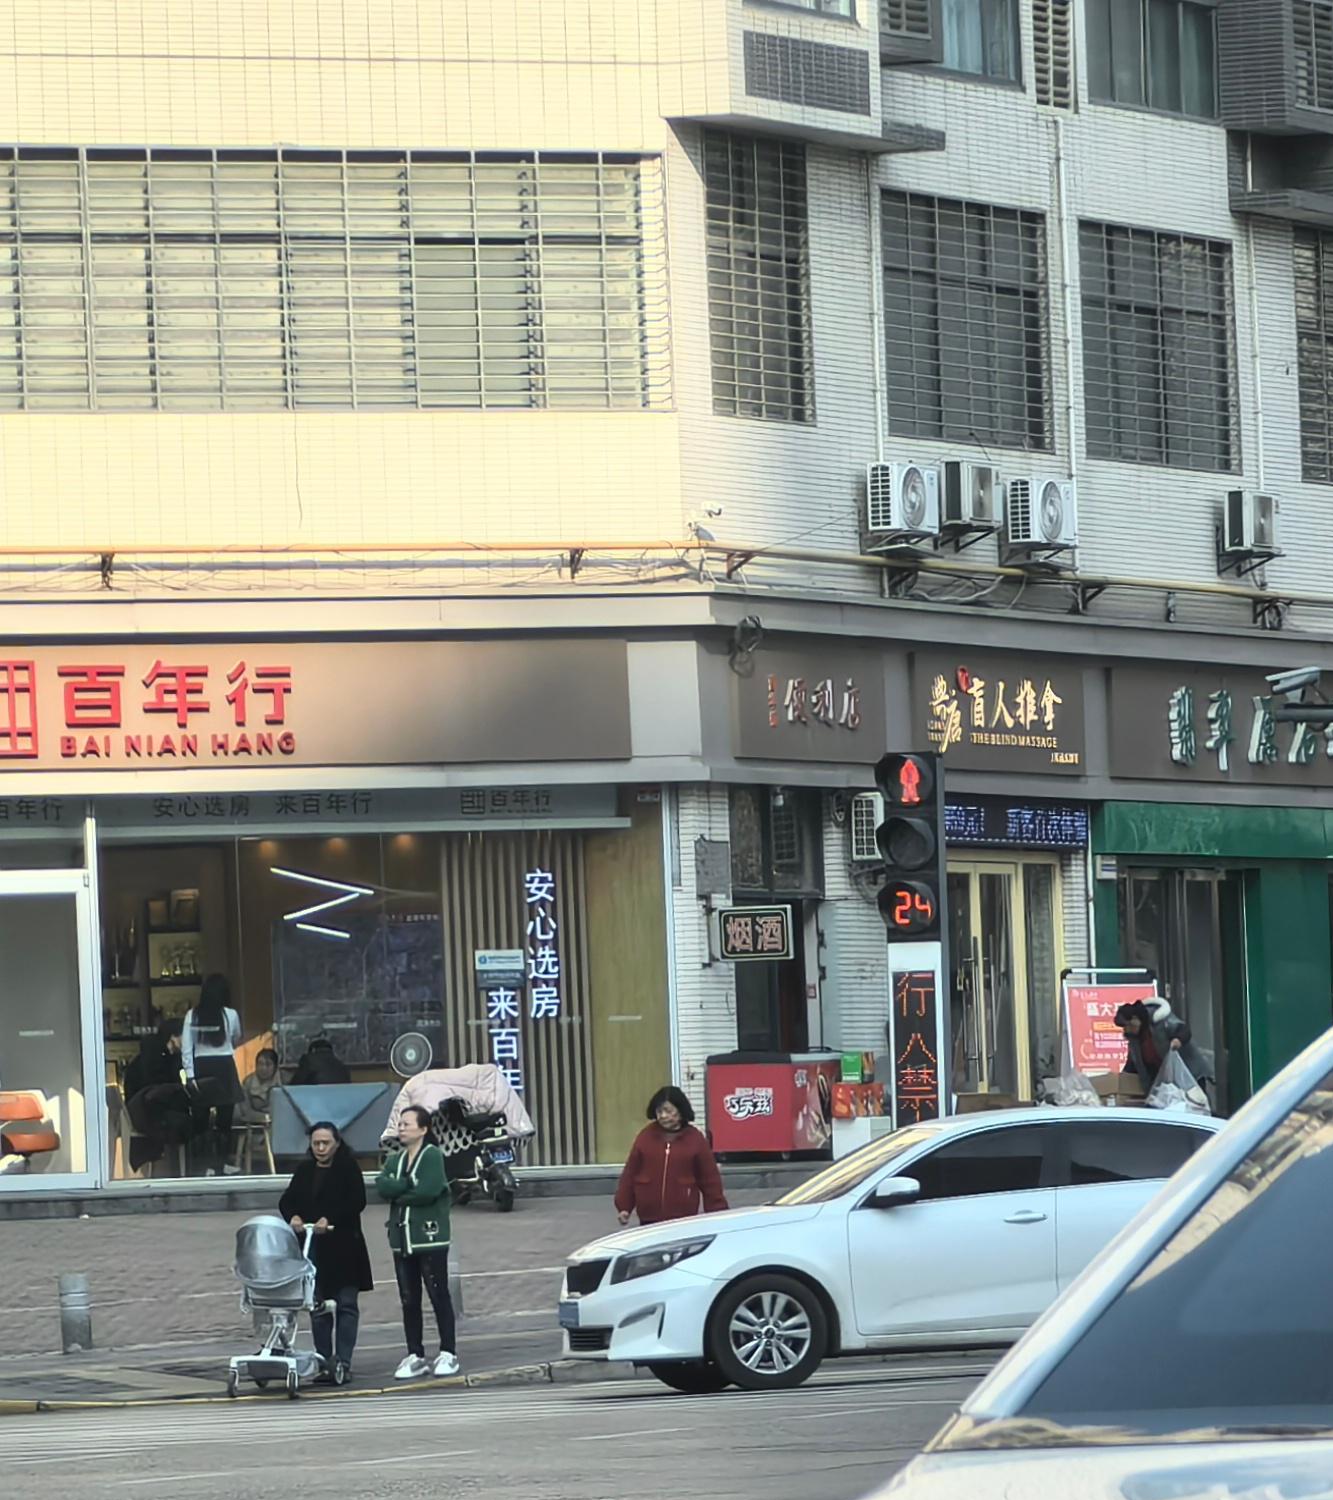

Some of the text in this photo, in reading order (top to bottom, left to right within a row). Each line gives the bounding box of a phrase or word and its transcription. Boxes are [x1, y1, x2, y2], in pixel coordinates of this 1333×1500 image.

[57, 660, 292, 728] 百年行
[784, 677, 861, 730] 便利店
[967, 677, 1063, 732] 盲人推拿
[60, 730, 296, 757] BAI NIAN HANG
[153, 791, 373, 819] 安心选房 来百年行
[893, 890, 932, 925] 24
[523, 867, 561, 1020] 安心选房
[726, 915, 784, 953] 烟酒
